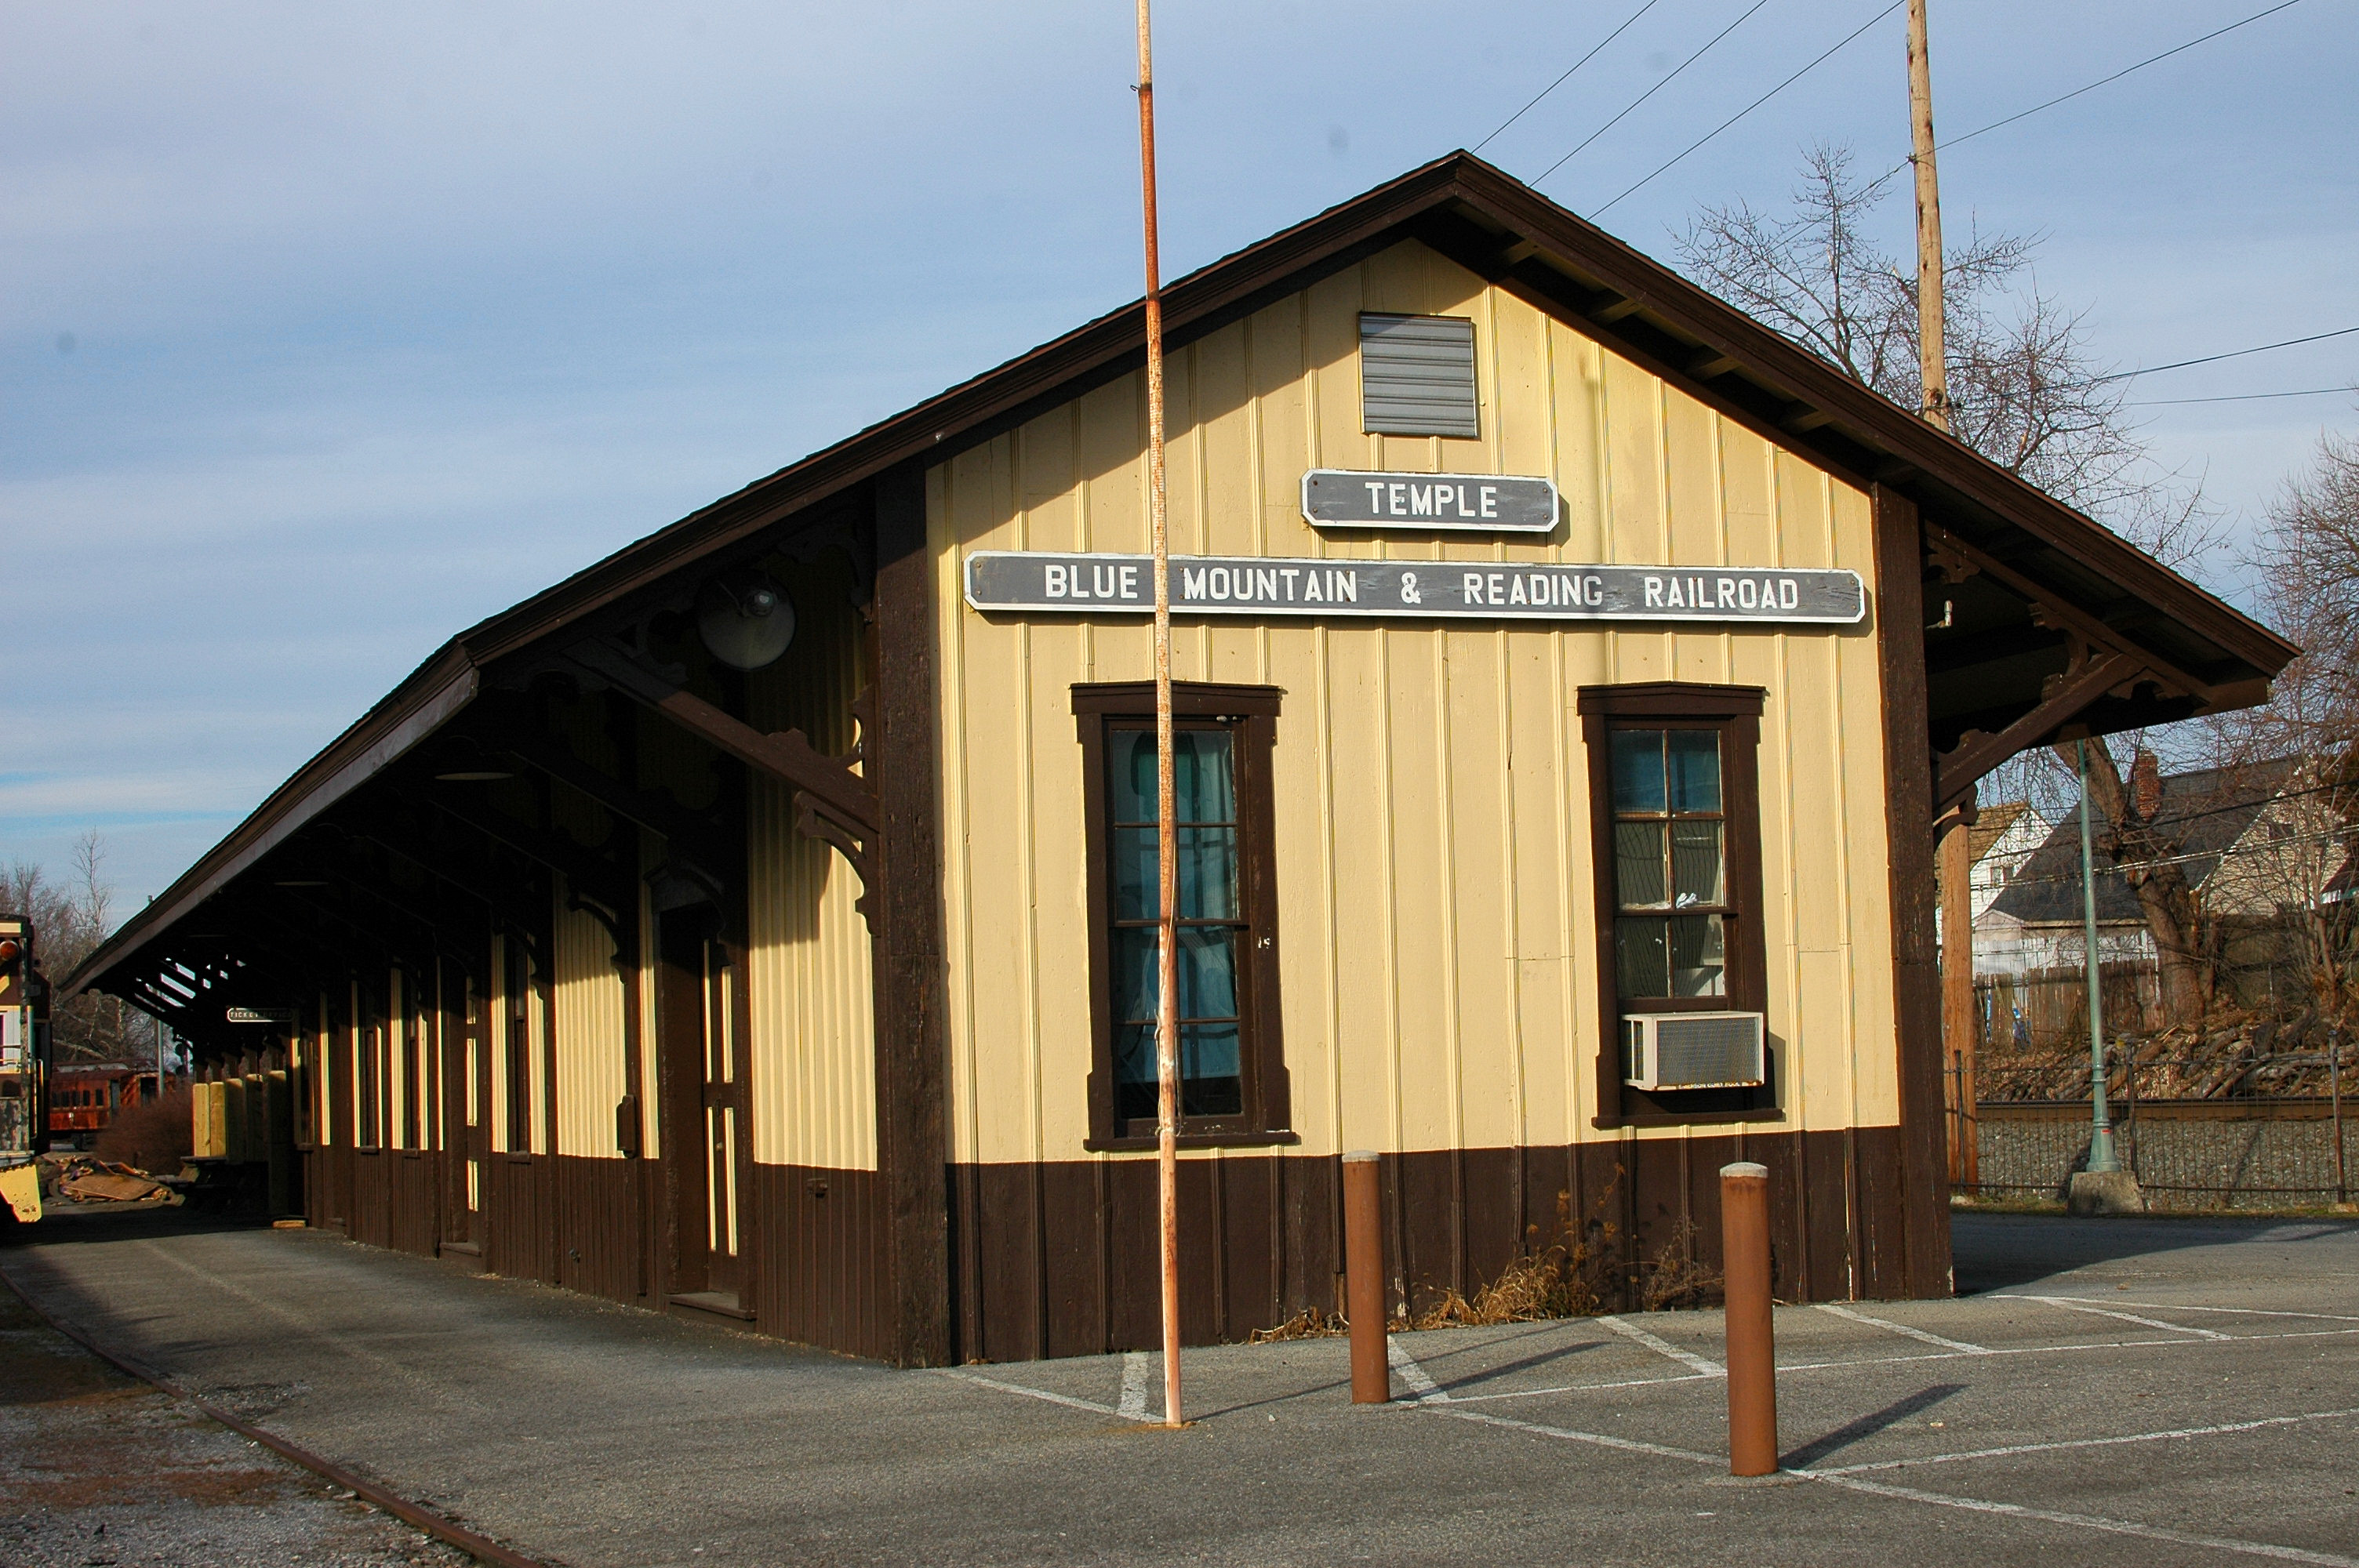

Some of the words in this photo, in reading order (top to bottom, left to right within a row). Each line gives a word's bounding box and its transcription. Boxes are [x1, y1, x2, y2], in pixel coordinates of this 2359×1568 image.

[1365, 481, 1498, 518] TEMPLE
[1045, 564, 1138, 598] BLUE
[1183, 567, 1358, 603] MOUNTAIN
[1401, 572, 1422, 604] &
[1463, 572, 1603, 607] READING
[1645, 577, 1798, 610] RAILROAD
